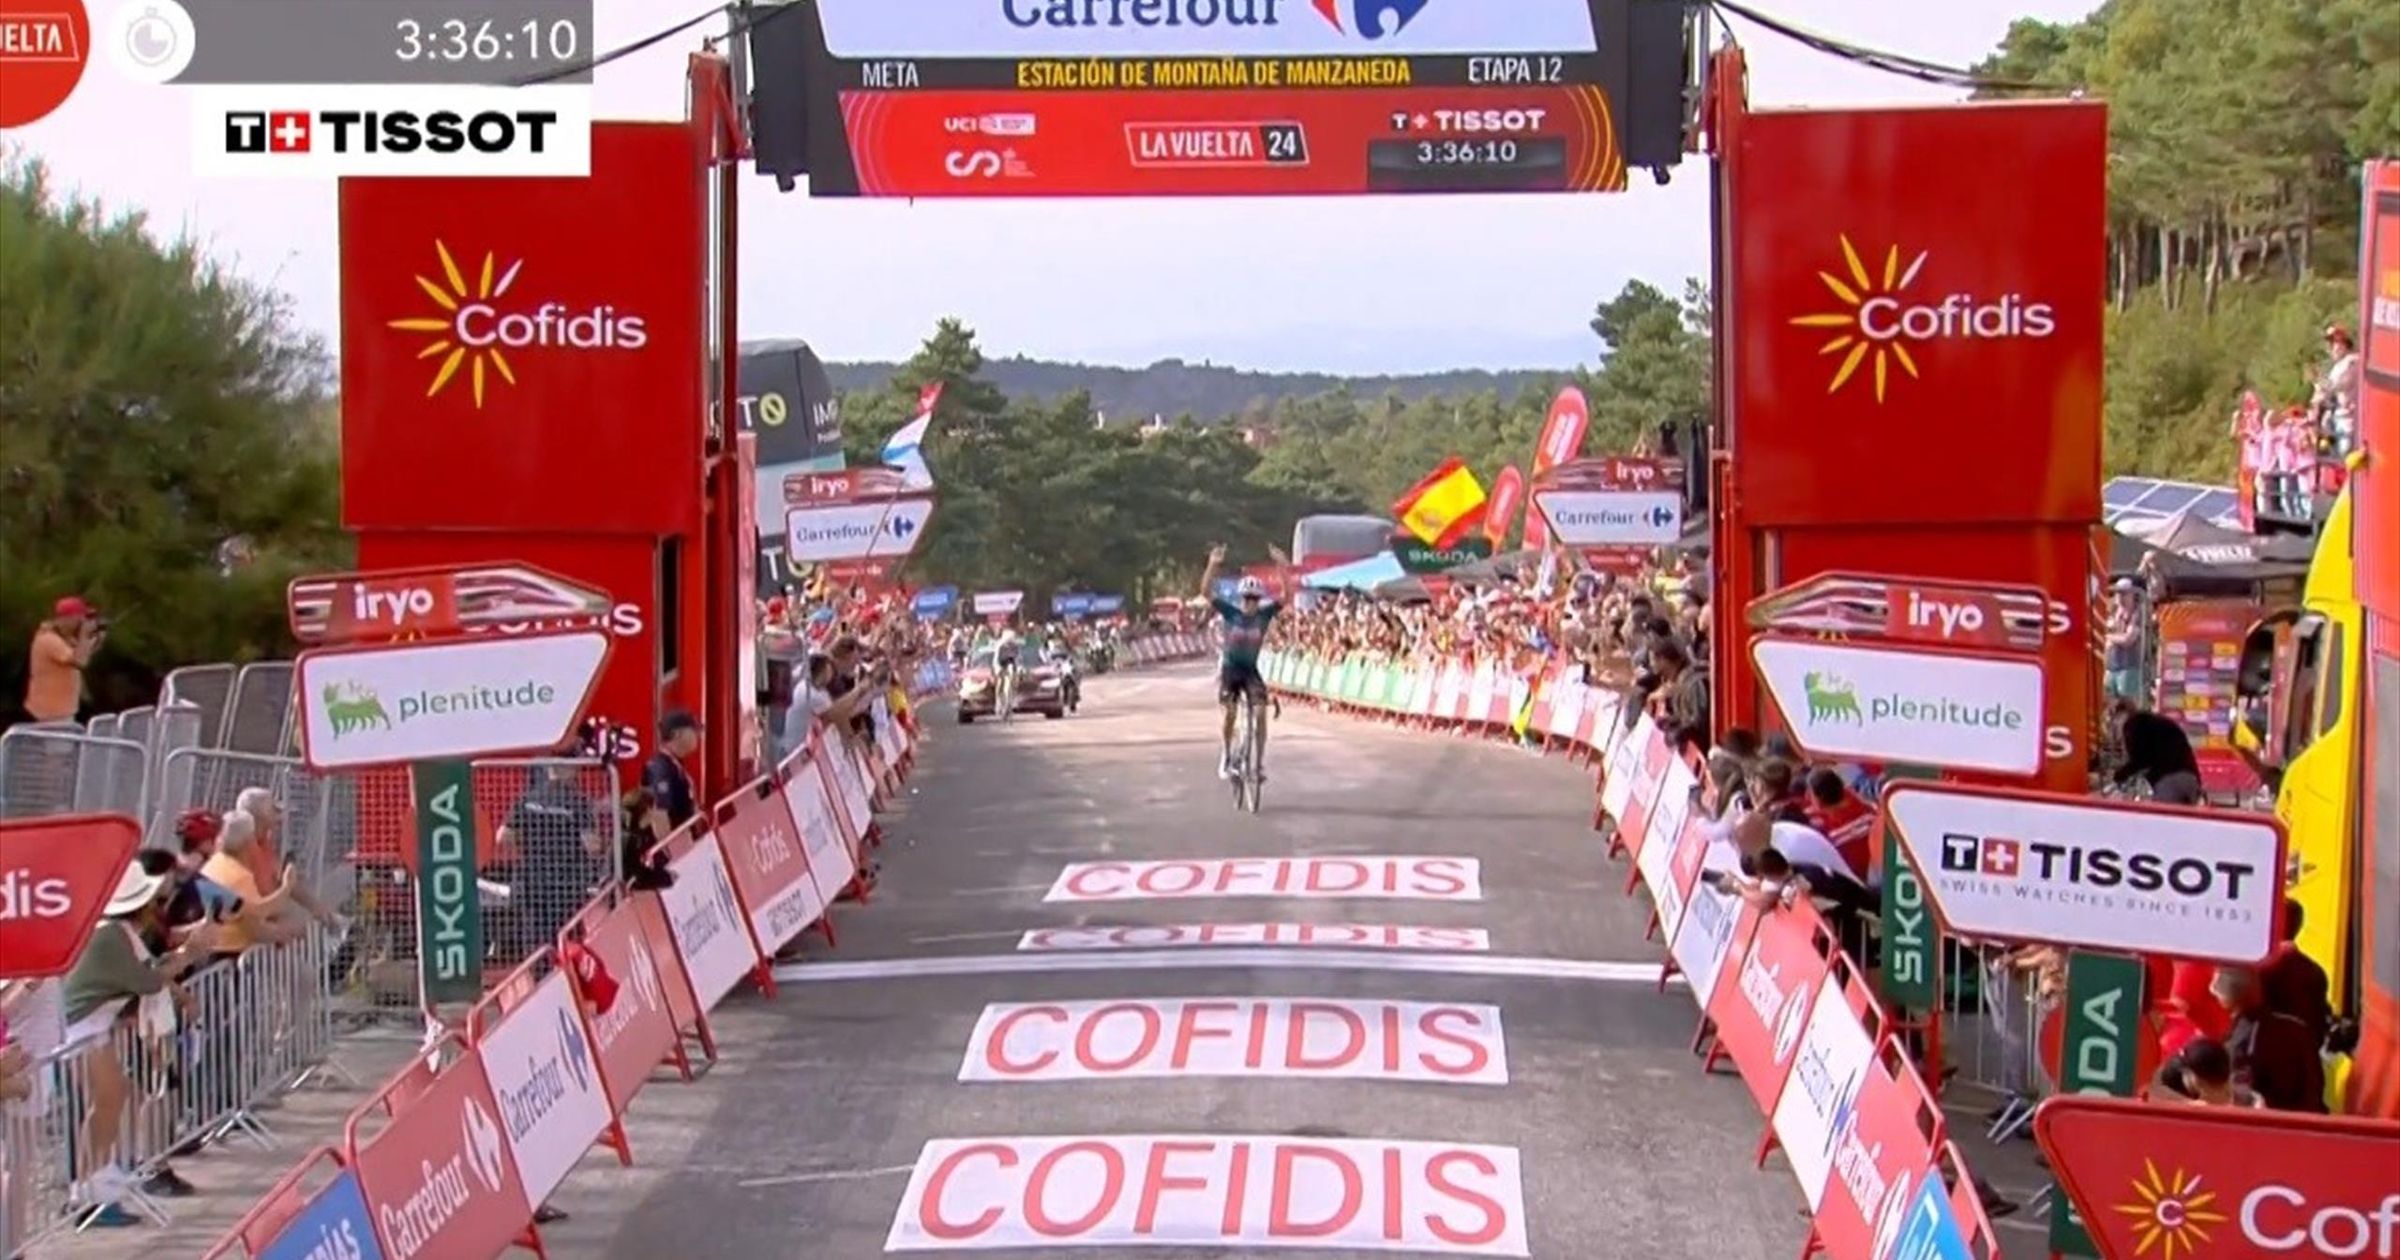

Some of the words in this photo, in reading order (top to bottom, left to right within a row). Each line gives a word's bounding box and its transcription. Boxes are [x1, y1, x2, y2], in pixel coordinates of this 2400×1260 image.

[862, 62, 919, 88] META
[1017, 58, 1114, 88] ESTACIÓN
[1120, 60, 1147, 86] DE
[1153, 57, 1247, 86] MONTAÑA
[1254, 60, 1281, 85] DE
[1286, 58, 1411, 85] MANZANEDA
[1468, 57, 1532, 83] ETAPA
[1540, 57, 1563, 83] 12
[1434, 109, 1546, 132] TISSOT
[1140, 131, 1167, 158] LA
[1171, 130, 1253, 158] VUELTA
[1268, 131, 1297, 157] 24
[1417, 141, 1517, 164] 3:36:10
[456, 304, 648, 349] Cofidis
[1859, 293, 2055, 339] Cofidis
[1556, 510, 1634, 526] Carrefour
[355, 584, 434, 623] iryo
[1909, 593, 1984, 638] iryo
[399, 681, 555, 722] plenitude
[1871, 693, 2023, 730] plenitude
[1065, 858, 1467, 897] COFIDIS
[2030, 842, 2254, 900] TISSOT
[1030, 923, 1472, 948] COFIDIS
[985, 1001, 1490, 1076] COFIDIS
[380, 1153, 470, 1260] Carrefour
[917, 1140, 1508, 1245] COFIDIS
